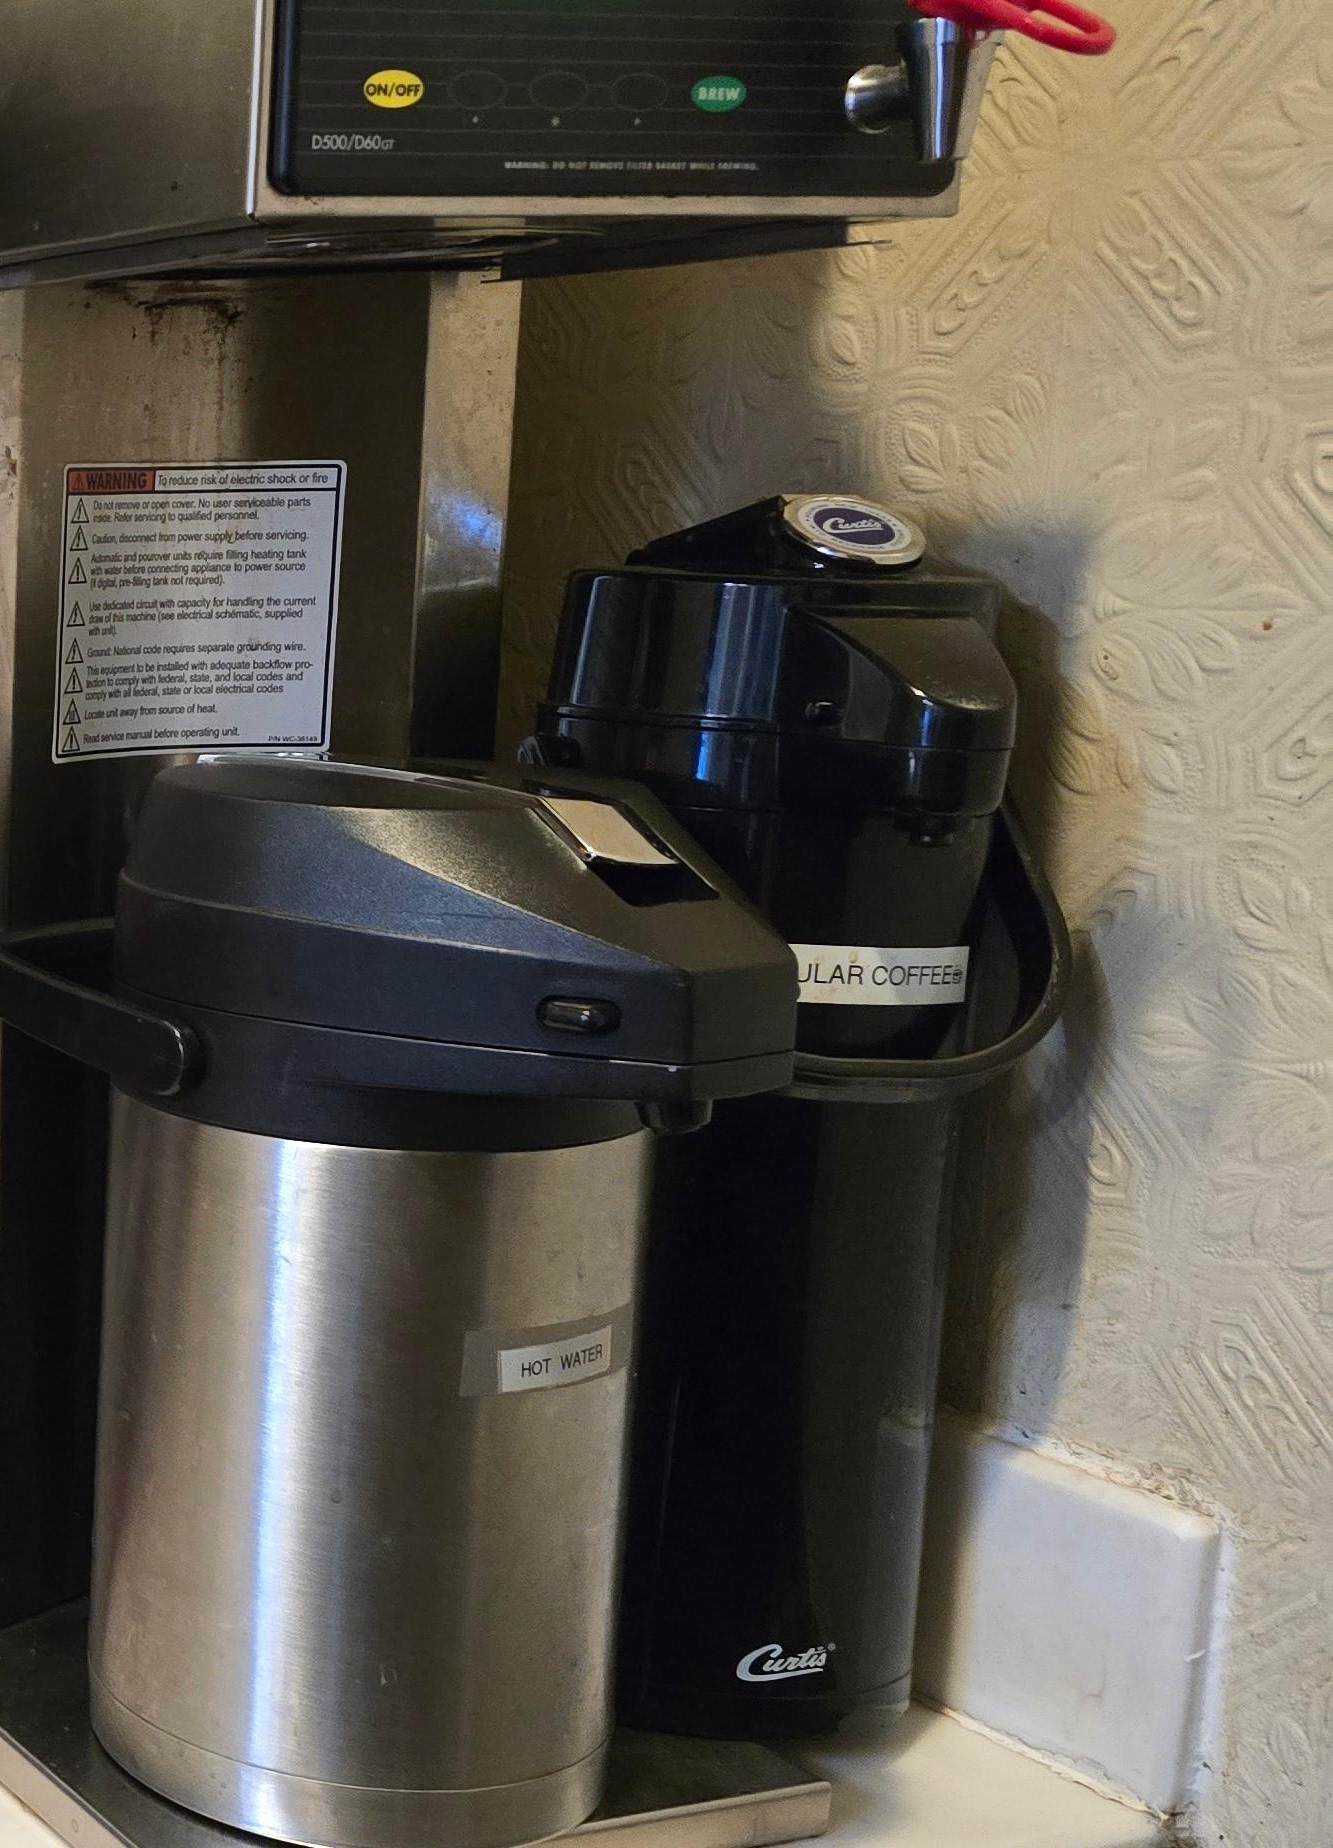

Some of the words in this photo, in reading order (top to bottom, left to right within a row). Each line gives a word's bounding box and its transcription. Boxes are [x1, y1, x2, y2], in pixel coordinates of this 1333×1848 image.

[365, 83, 421, 97] ON/OFF
[698, 87, 740, 100] BREW
[86, 472, 146, 490] WARNING
[158, 475, 167, 486] To
[169, 474, 199, 485] reduce
[201, 474, 217, 484] risk
[218, 474, 229, 484] of
[230, 473, 265, 484] electric
[267, 473, 296, 483] shock
[299, 474, 309, 483] or
[312, 472, 328, 483] fire
[93, 500, 103, 510] Do
[115, 502, 140, 510] remove
[142, 501, 150, 509] or
[151, 501, 169, 511] open
[172, 501, 195, 509] cover.
[198, 499, 210, 508] No
[213, 500, 231, 508] user
[234, 498, 285, 508] serviceable
[287, 498, 311, 509] parts
[135, 513, 166, 524] servicing
[168, 512, 175, 521] to
[177, 511, 212, 522] qualified
[214, 510, 259, 521] personnel.
[822, 517, 884, 534] Curtis
[159, 532, 176, 542] from
[178, 533, 202, 542] power
[205, 530, 231, 542] supply
[235, 530, 263, 540] before
[266, 530, 308, 541] servicing.
[173, 551, 192, 560] units
[194, 550, 223, 560] require
[226, 550, 248, 560] filling
[251, 549, 283, 560] heating
[287, 549, 306, 558] tank
[123, 565, 145, 574] before
[148, 564, 188, 575] connecting
[191, 563, 231, 574] appliance
[234, 563, 242, 572] to
[245, 563, 272, 573] power
[275, 562, 306, 571] source
[171, 576, 183, 585] not
[160, 599, 175, 608] with
[177, 598, 211, 609] capacity
[213, 597, 223, 607] for
[226, 597, 264, 608] handling
[267, 596, 281, 606] the
[283, 597, 316, 606] current
[177, 610, 213, 620] electrical
[215, 609, 262, 619] schematic,
[265, 608, 303, 620] supplied
[143, 645, 161, 654] code
[163, 644, 195, 655] requires
[198, 643, 234, 654] separate
[237, 642, 281, 653] grounding
[284, 642, 306, 651] wire.
[145, 663, 155, 672] be
[157, 661, 189, 671] installed
[191, 660, 207, 670] with
[210, 660, 250, 671] adequate
[253, 660, 293, 669] backflow
[295, 661, 314, 671] pro-
[190, 673, 212, 683] state,
[215, 672, 231, 681] and
[233, 672, 253, 681] local
[256, 672, 283, 681] codes
[286, 672, 303, 681] and
[162, 686, 181, 695] state
[194, 685, 213, 694] local
[215, 684, 253, 694] electrical
[256, 684, 284, 693] codes
[140, 706, 156, 716] from
[158, 706, 184, 715] source
[187, 704, 195, 713] of
[197, 704, 217, 713] heat.
[101, 732, 124, 742] service
[126, 730, 152, 740] manual
[154, 728, 179, 738] before
[181, 727, 219, 739] operating
[222, 727, 240, 736] unit.
[798, 963, 863, 984] ULAR
[872, 965, 953, 986] COFFEE
[521, 1358, 552, 1378] HOT
[560, 1344, 603, 1370] WATER
[736, 1643, 827, 1681] Curtis
